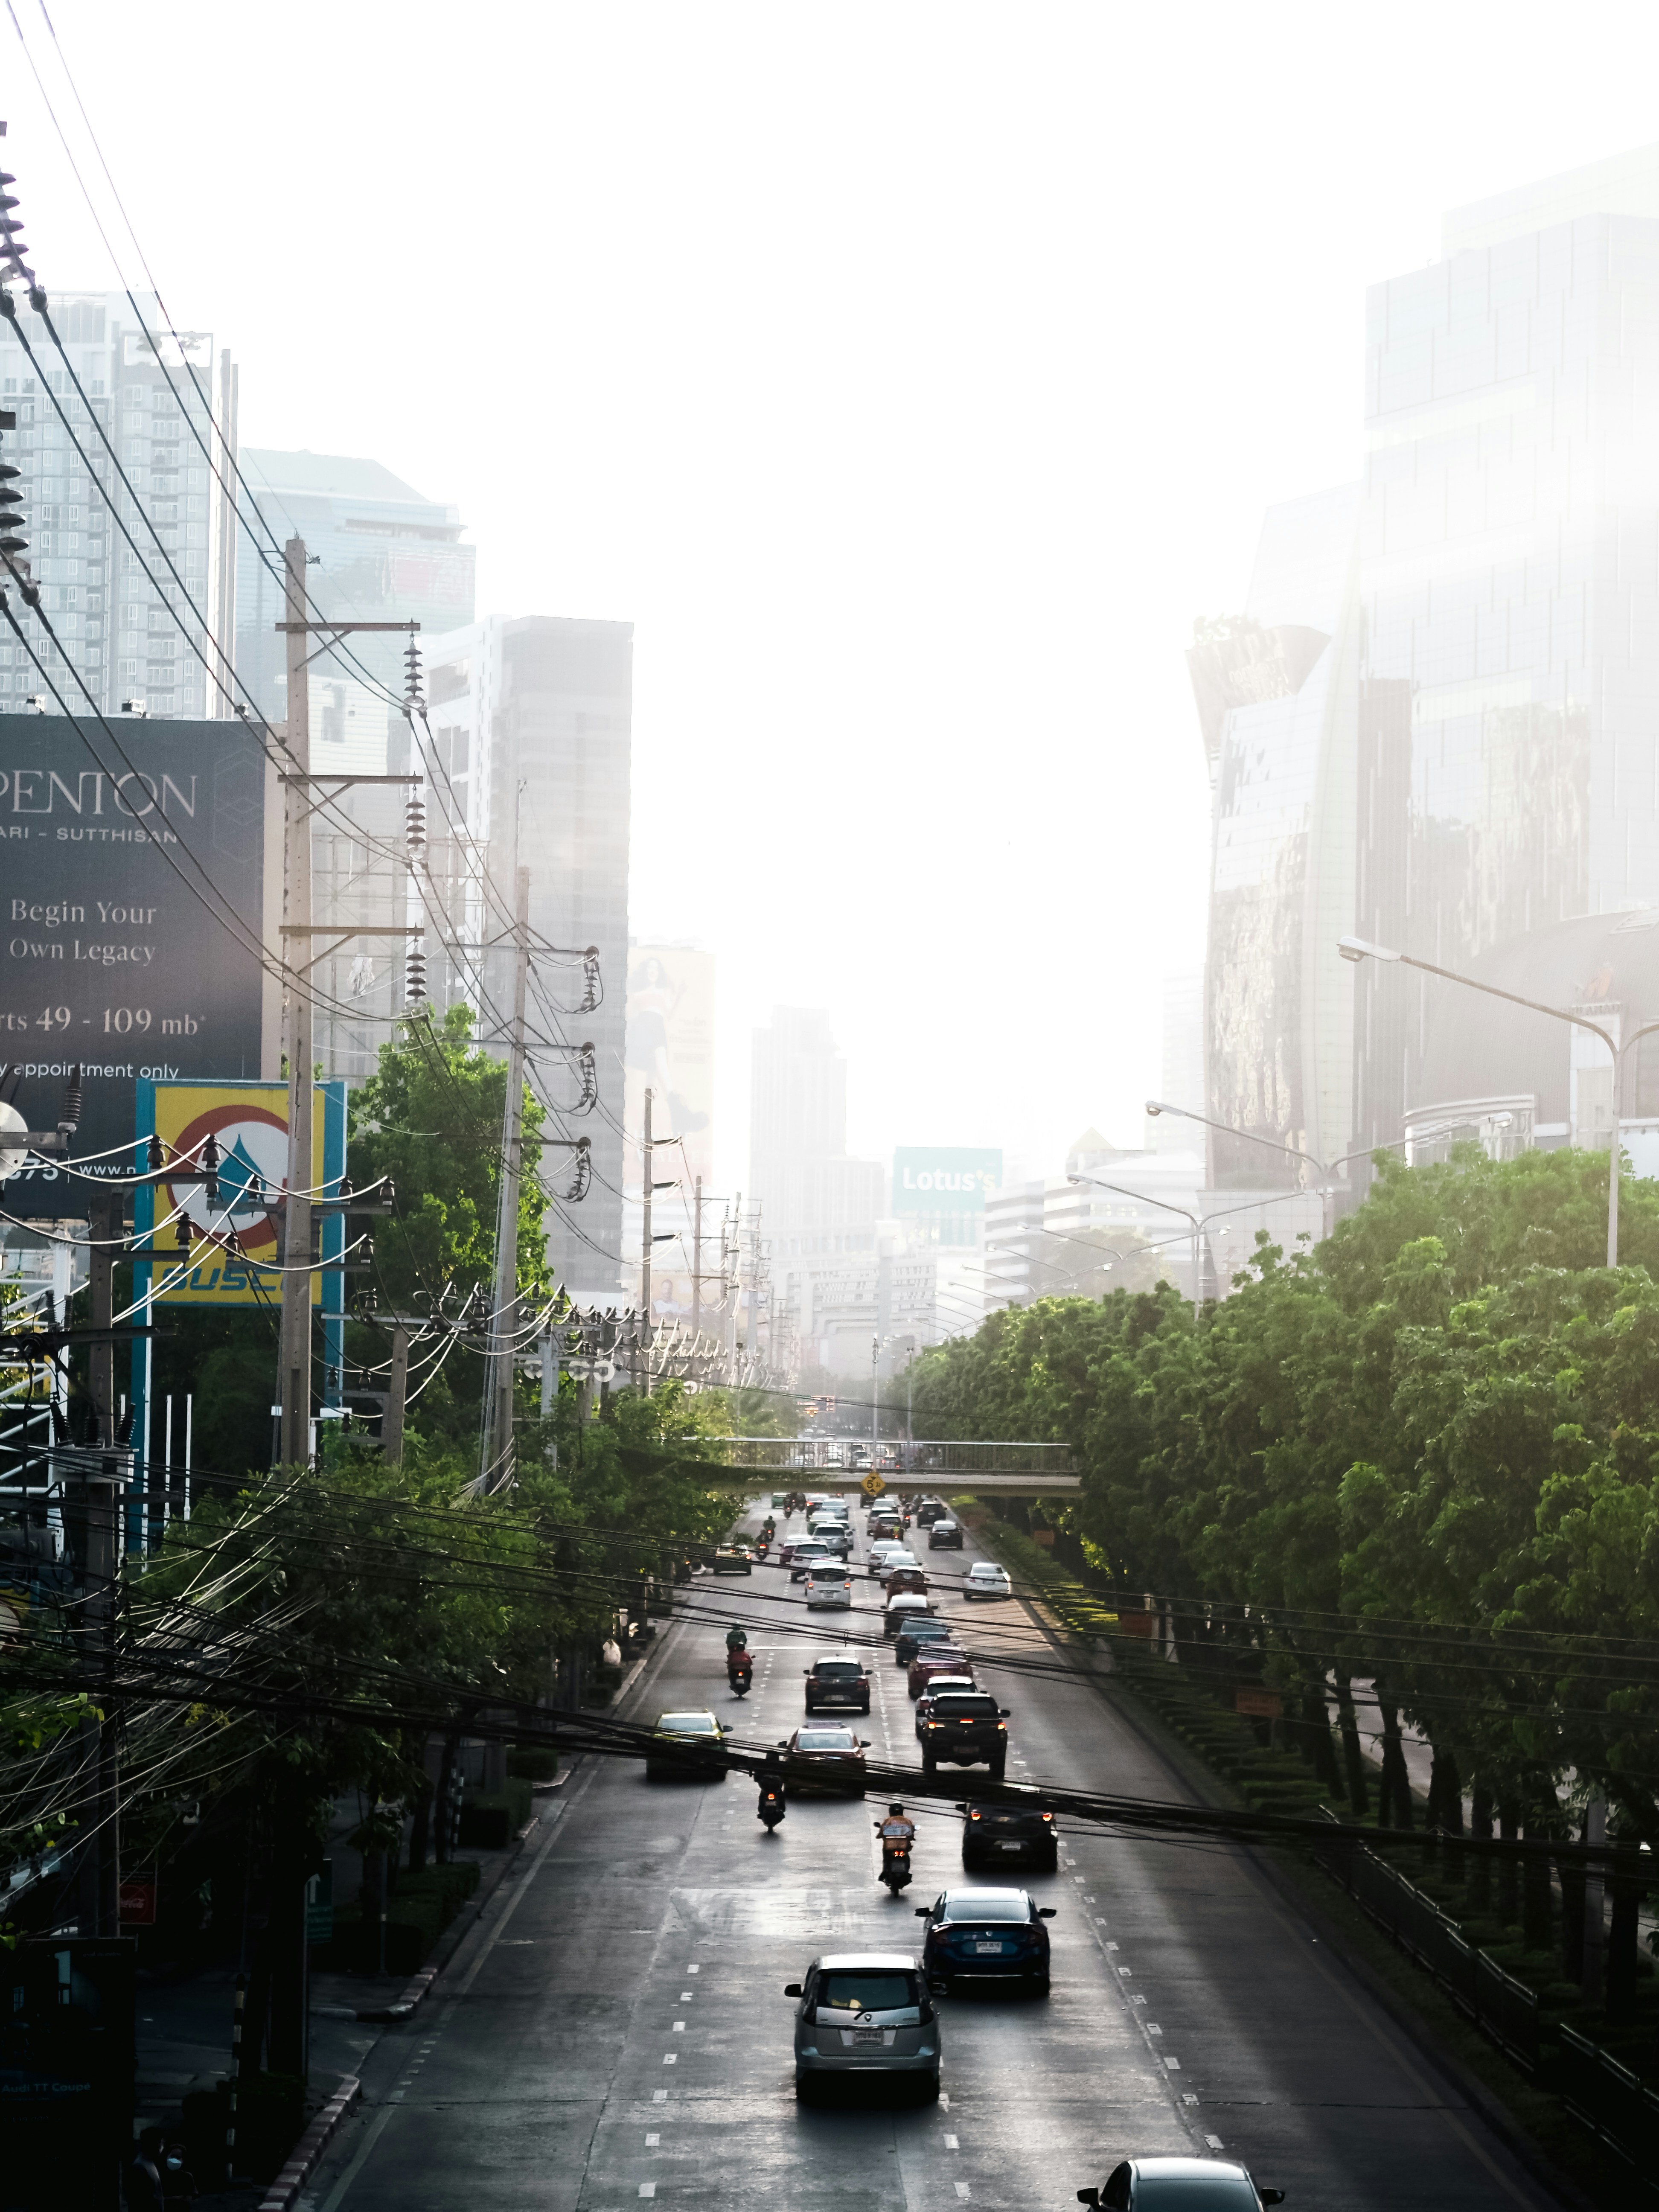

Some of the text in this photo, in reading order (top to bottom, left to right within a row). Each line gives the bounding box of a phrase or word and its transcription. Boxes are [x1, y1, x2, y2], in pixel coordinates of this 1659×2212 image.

[57, 827, 177, 844] SUTTHISAN
[12, 899, 157, 927] Begin Your
[9, 939, 156, 967] Own Legacy
[36, 1007, 71, 1032] 49
[102, 1008, 151, 1033] 109
[14, 1061, 133, 1078] appointment
[140, 1064, 179, 1080] only
[902, 1167, 996, 1192] Lotus's
[160, 1268, 285, 1292] SUSC
[867, 1480, 873, 1488] 5
[1, 2083, 30, 2093] Audi
[33, 2084, 49, 2092] TT
